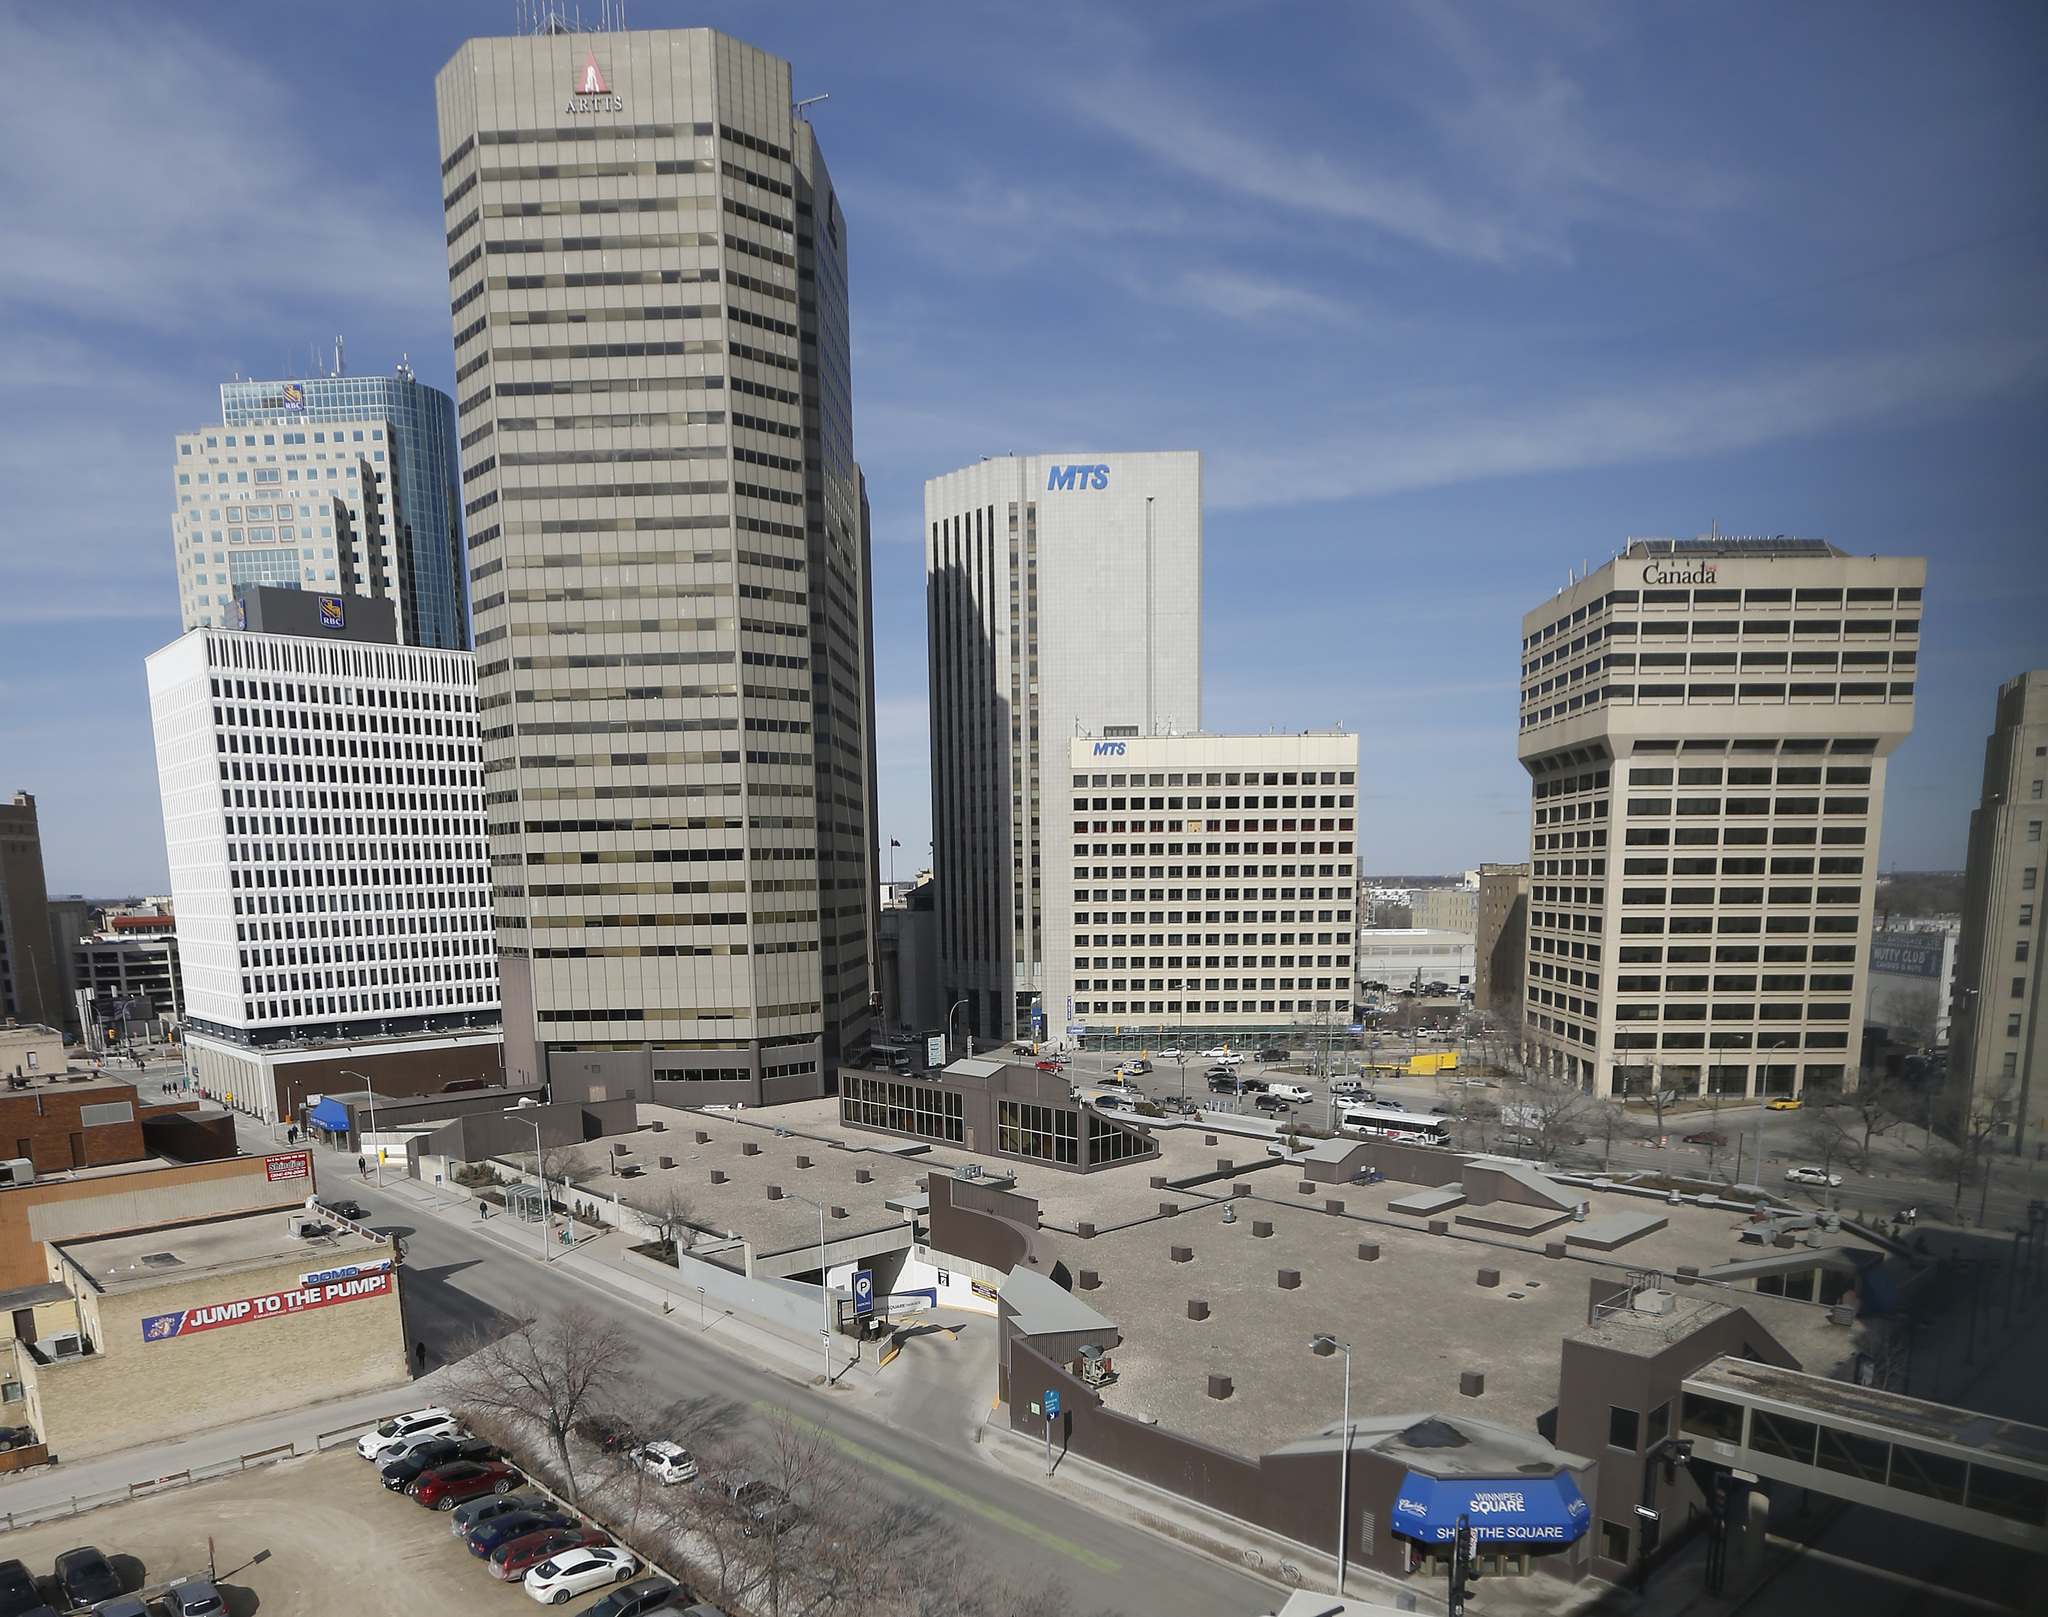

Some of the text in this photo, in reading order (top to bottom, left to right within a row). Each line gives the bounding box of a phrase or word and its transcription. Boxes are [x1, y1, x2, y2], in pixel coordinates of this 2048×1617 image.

[565, 96, 623, 114] ARTIS
[1047, 464, 1110, 490] MTS
[1642, 561, 1717, 585] Canada
[323, 617, 341, 625] RBC
[1093, 742, 1126, 756] MTS
[1873, 947, 1926, 964] NUTTY CLUB
[307, 1266, 361, 1284] DOMO
[190, 1301, 251, 1328] JUMP
[253, 1296, 281, 1314] TO
[283, 1287, 322, 1308] THE
[325, 1275, 386, 1300] PUMP!
[1475, 1492, 1524, 1502] WINNIPEG
[1469, 1501, 1526, 1515] SQUARE
[1478, 1527, 1504, 1538] THE
[1506, 1527, 1564, 1538] SQUARE
